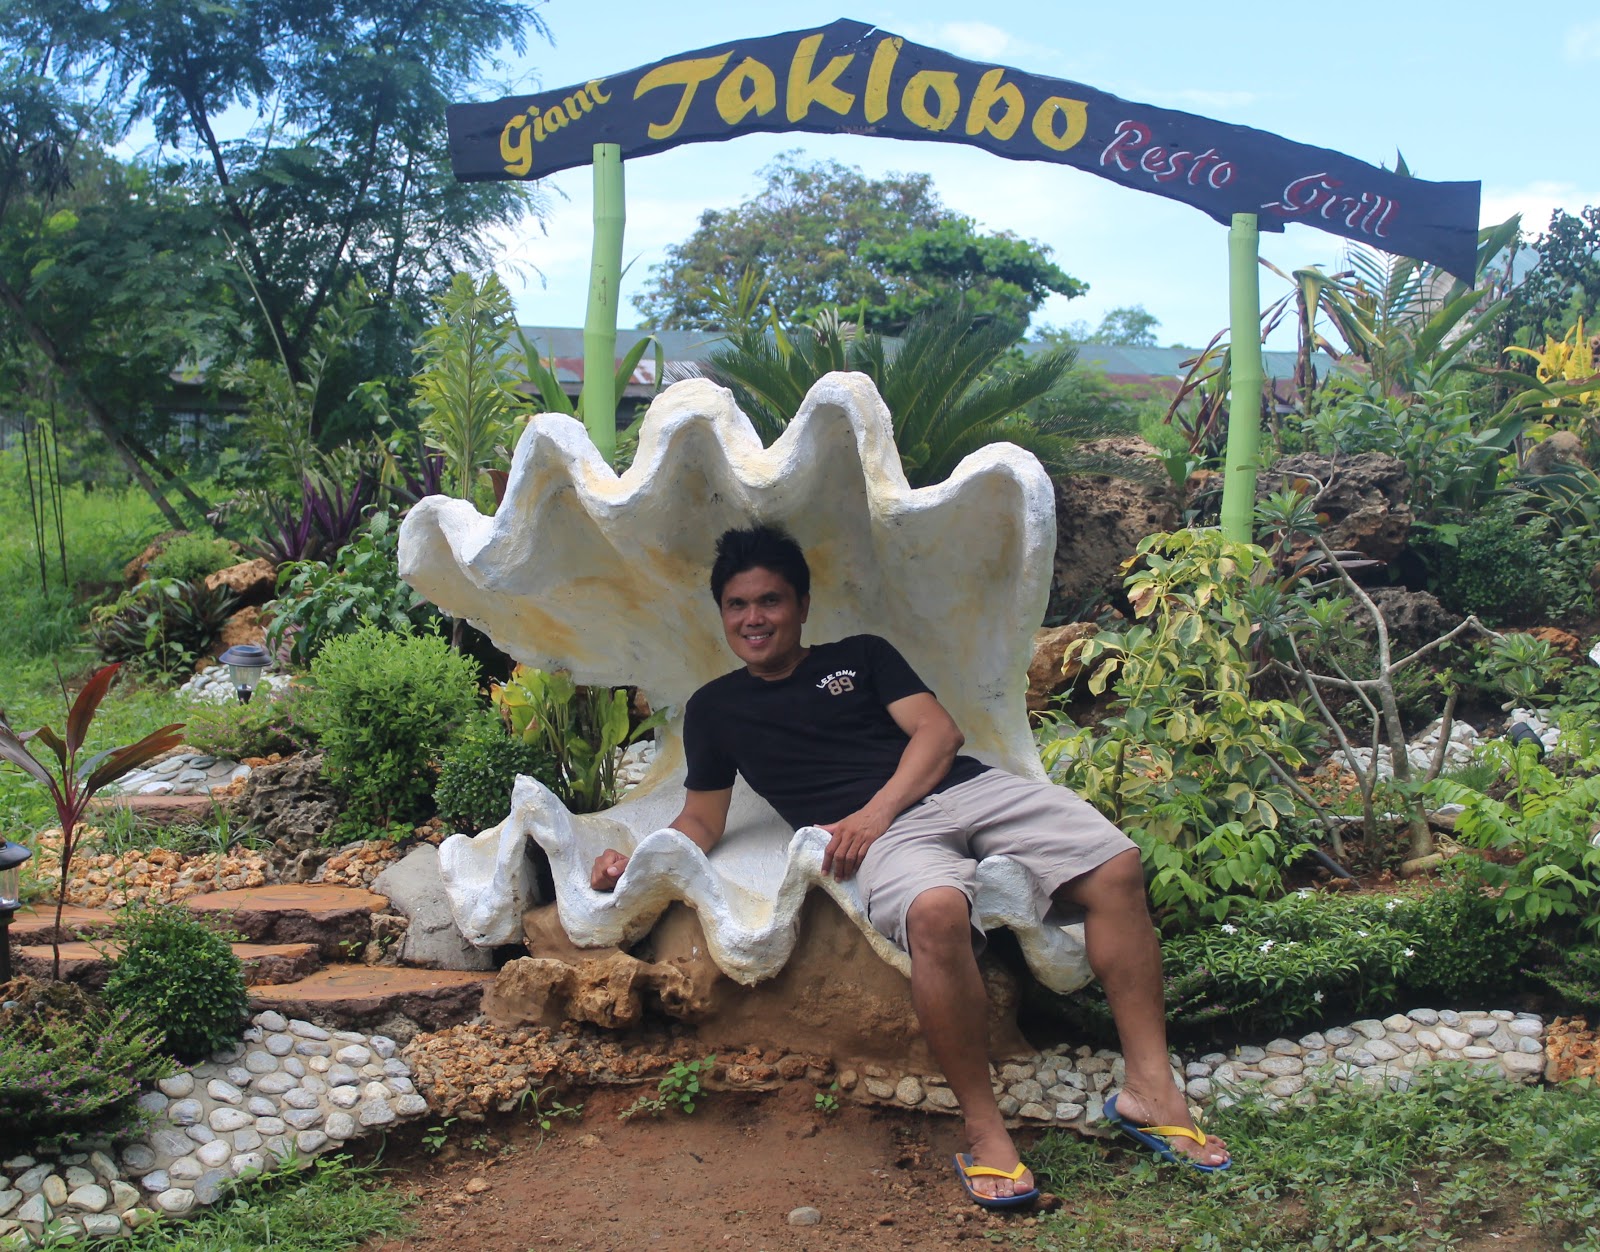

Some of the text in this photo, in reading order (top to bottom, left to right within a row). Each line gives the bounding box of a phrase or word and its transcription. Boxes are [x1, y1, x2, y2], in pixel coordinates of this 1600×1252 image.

[500, 33, 1399, 237] Giant Taklobo Resto Grill
[816, 674, 835, 688] LEE
[828, 676, 854, 696] 89
